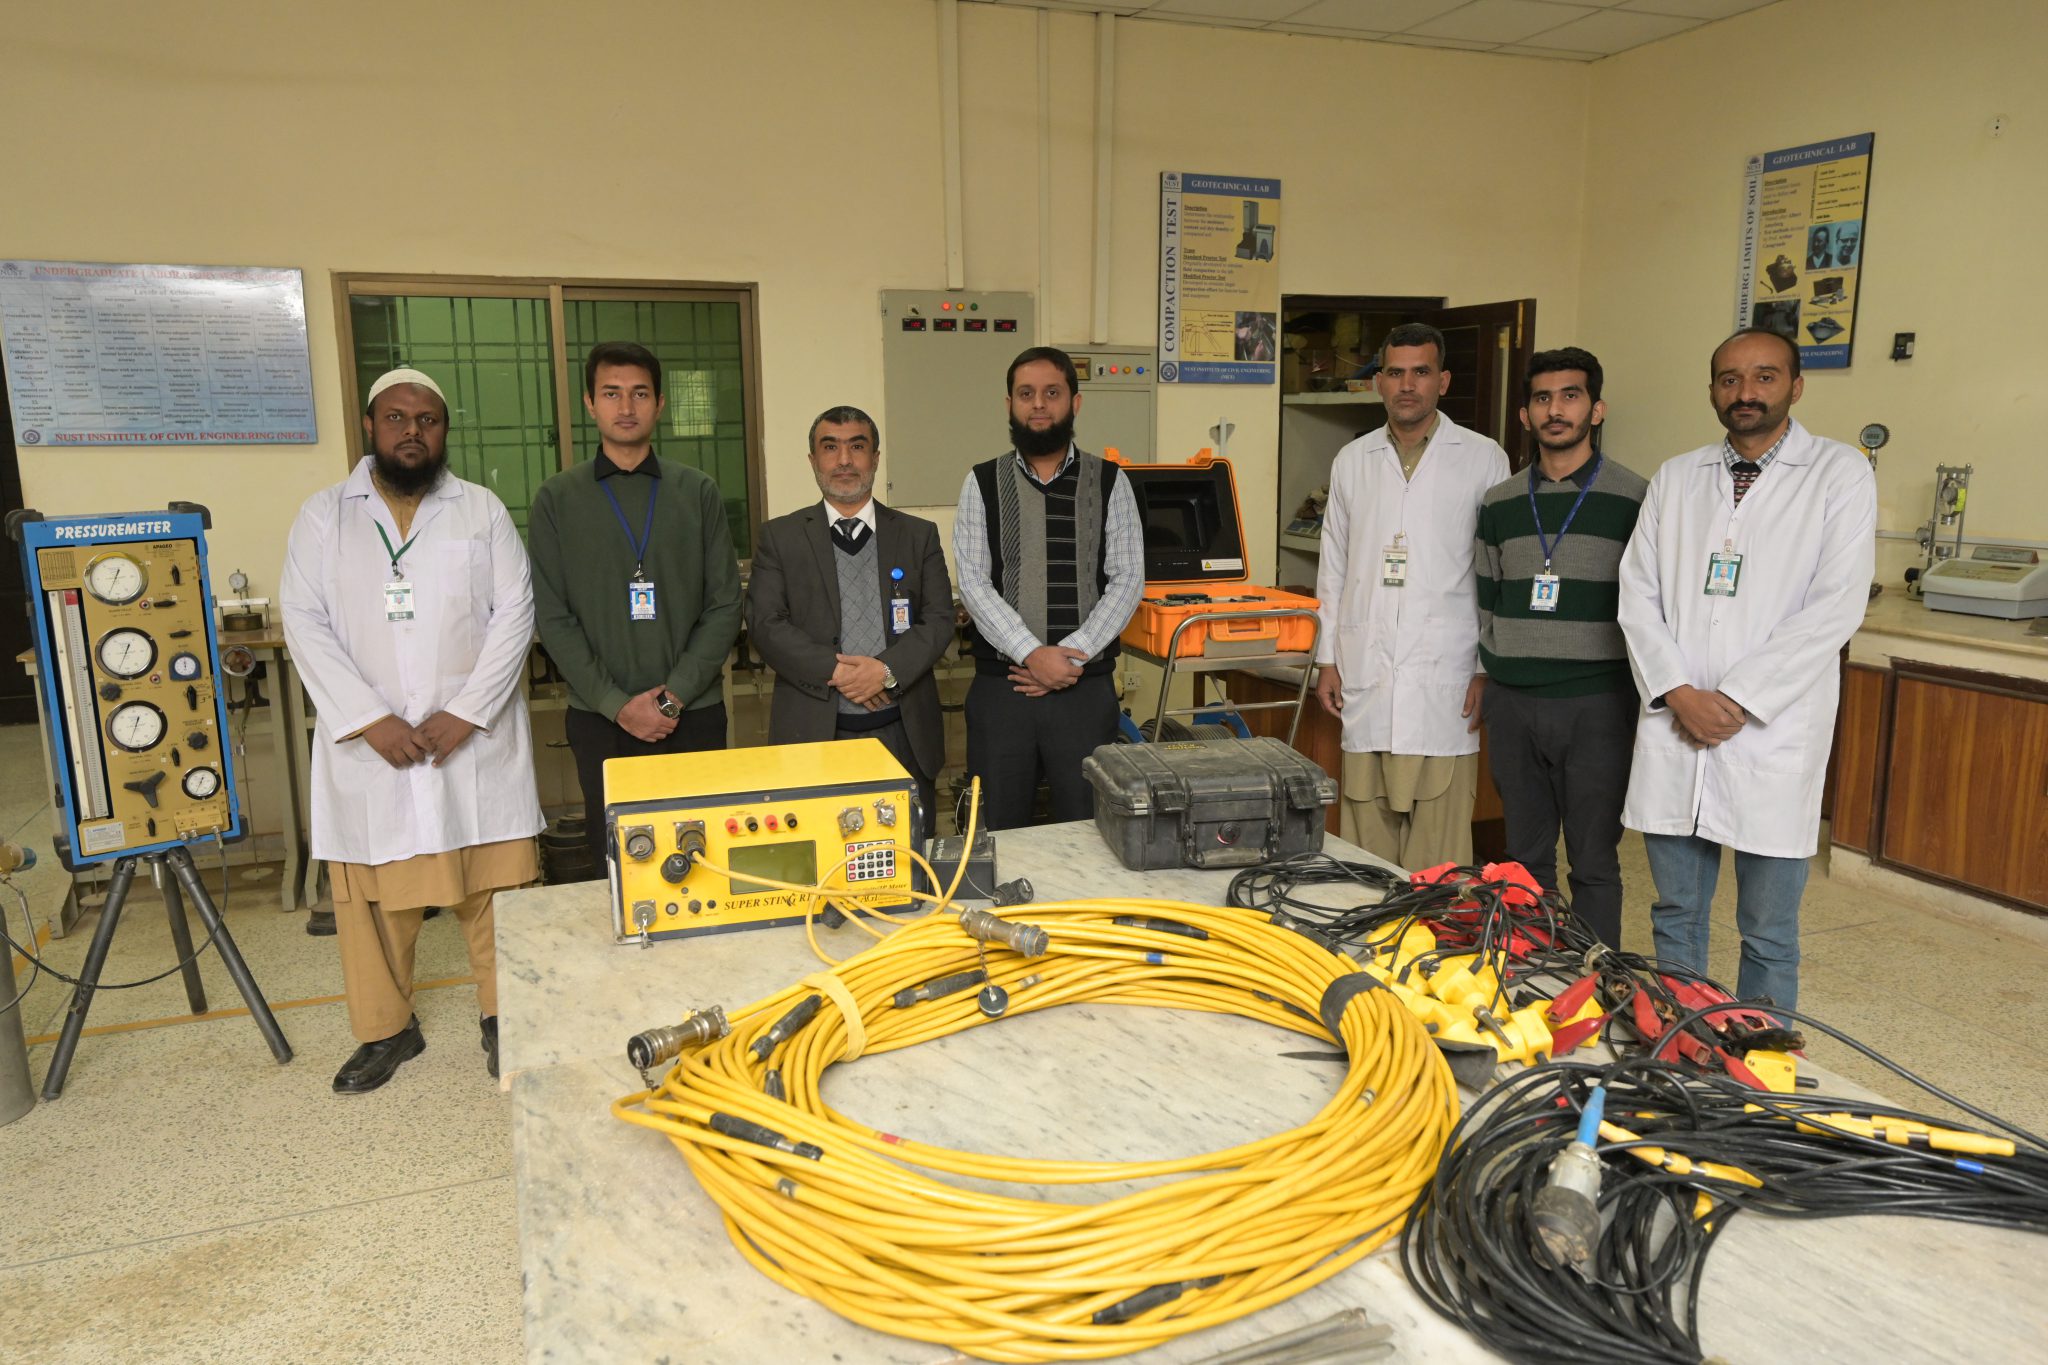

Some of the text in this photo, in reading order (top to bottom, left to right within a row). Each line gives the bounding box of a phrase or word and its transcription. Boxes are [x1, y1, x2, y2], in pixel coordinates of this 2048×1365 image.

[1772, 142, 1857, 165] GEOTECHNICAL LAB
[1191, 179, 1270, 193] GEOTECHNICAL LAB
[1747, 209, 1755, 225] OF
[1743, 227, 1753, 270] LIMITS
[34, 266, 139, 278] UNDERGRADUATE
[1164, 198, 1177, 352] COMPACTION TEST
[1739, 273, 1750, 328] TERBERG
[55, 432, 310, 442] NUST INSTITUTE OF CIVIL ENGINEERING (NICE)
[55, 520, 172, 540] PRESSUREMETER
[724, 896, 761, 910] SUPER
[763, 892, 797, 908] STING
